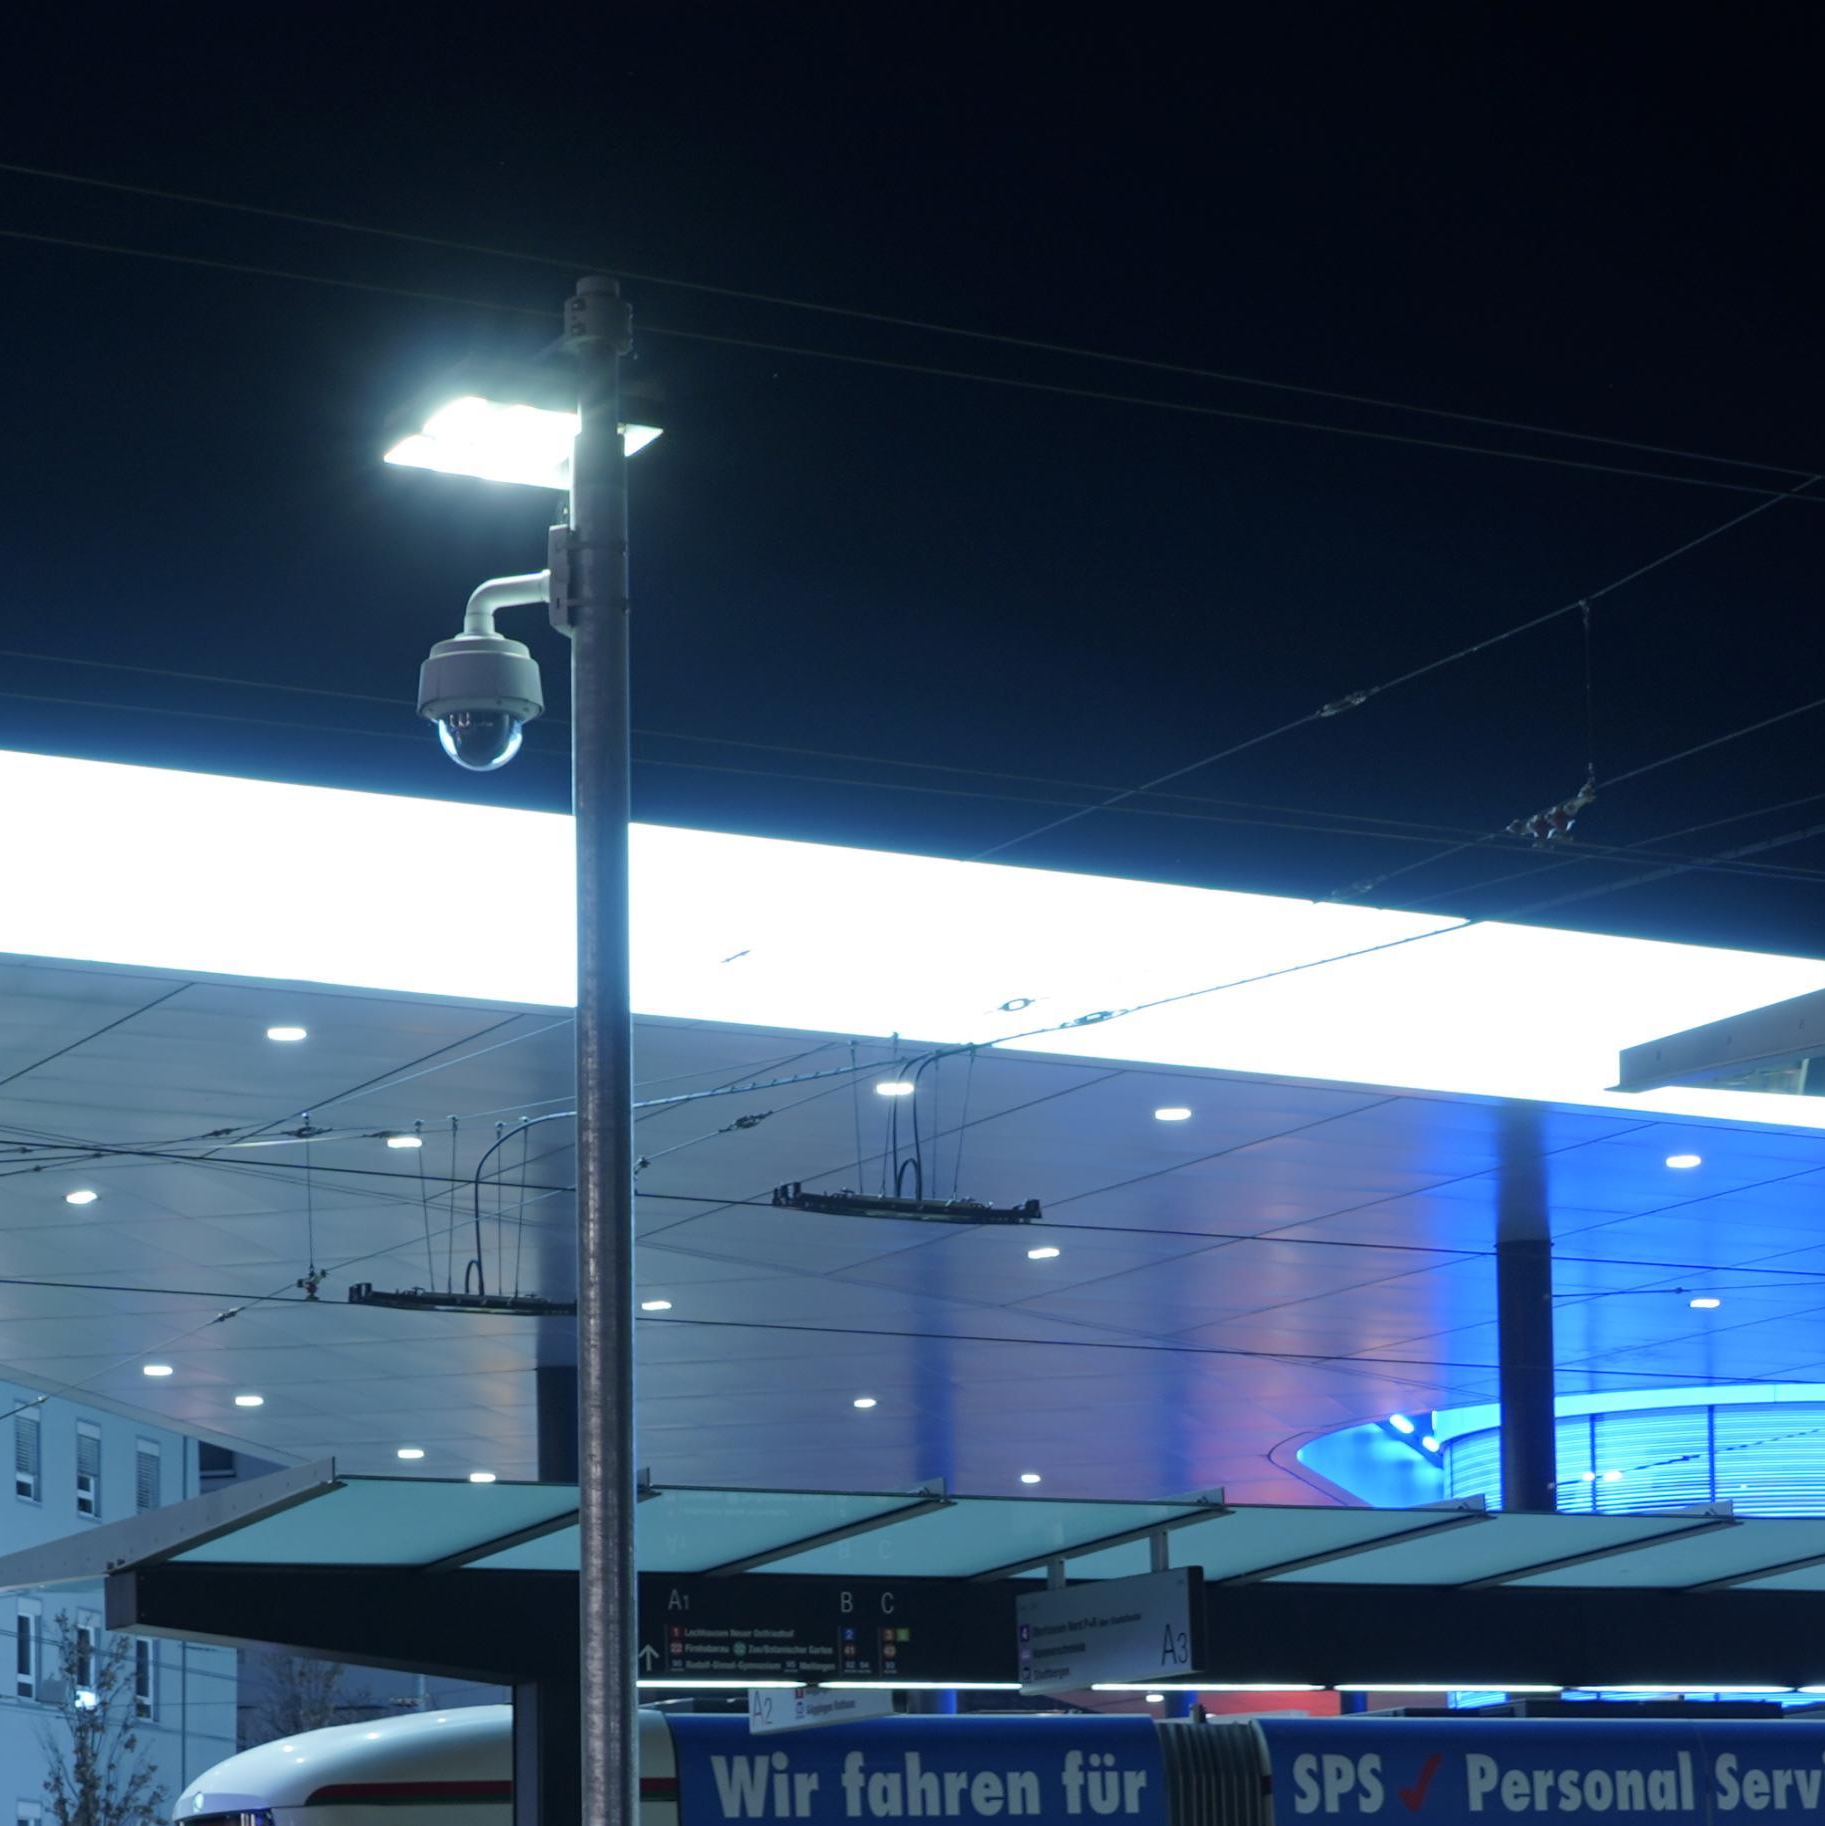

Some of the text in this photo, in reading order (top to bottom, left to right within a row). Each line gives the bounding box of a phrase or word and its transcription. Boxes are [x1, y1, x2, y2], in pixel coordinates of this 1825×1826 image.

[667, 1588, 690, 1611] A1
[840, 1591, 853, 1613] B
[880, 1591, 895, 1614] C
[845, 1628, 855, 1640] 2
[1161, 1623, 1188, 1666] A3
[753, 1690, 773, 1725] A2
[710, 1750, 1147, 1818] Wir fahren für
[1293, 1752, 1385, 1813] SPS
[1466, 1750, 1696, 1812] Personal
